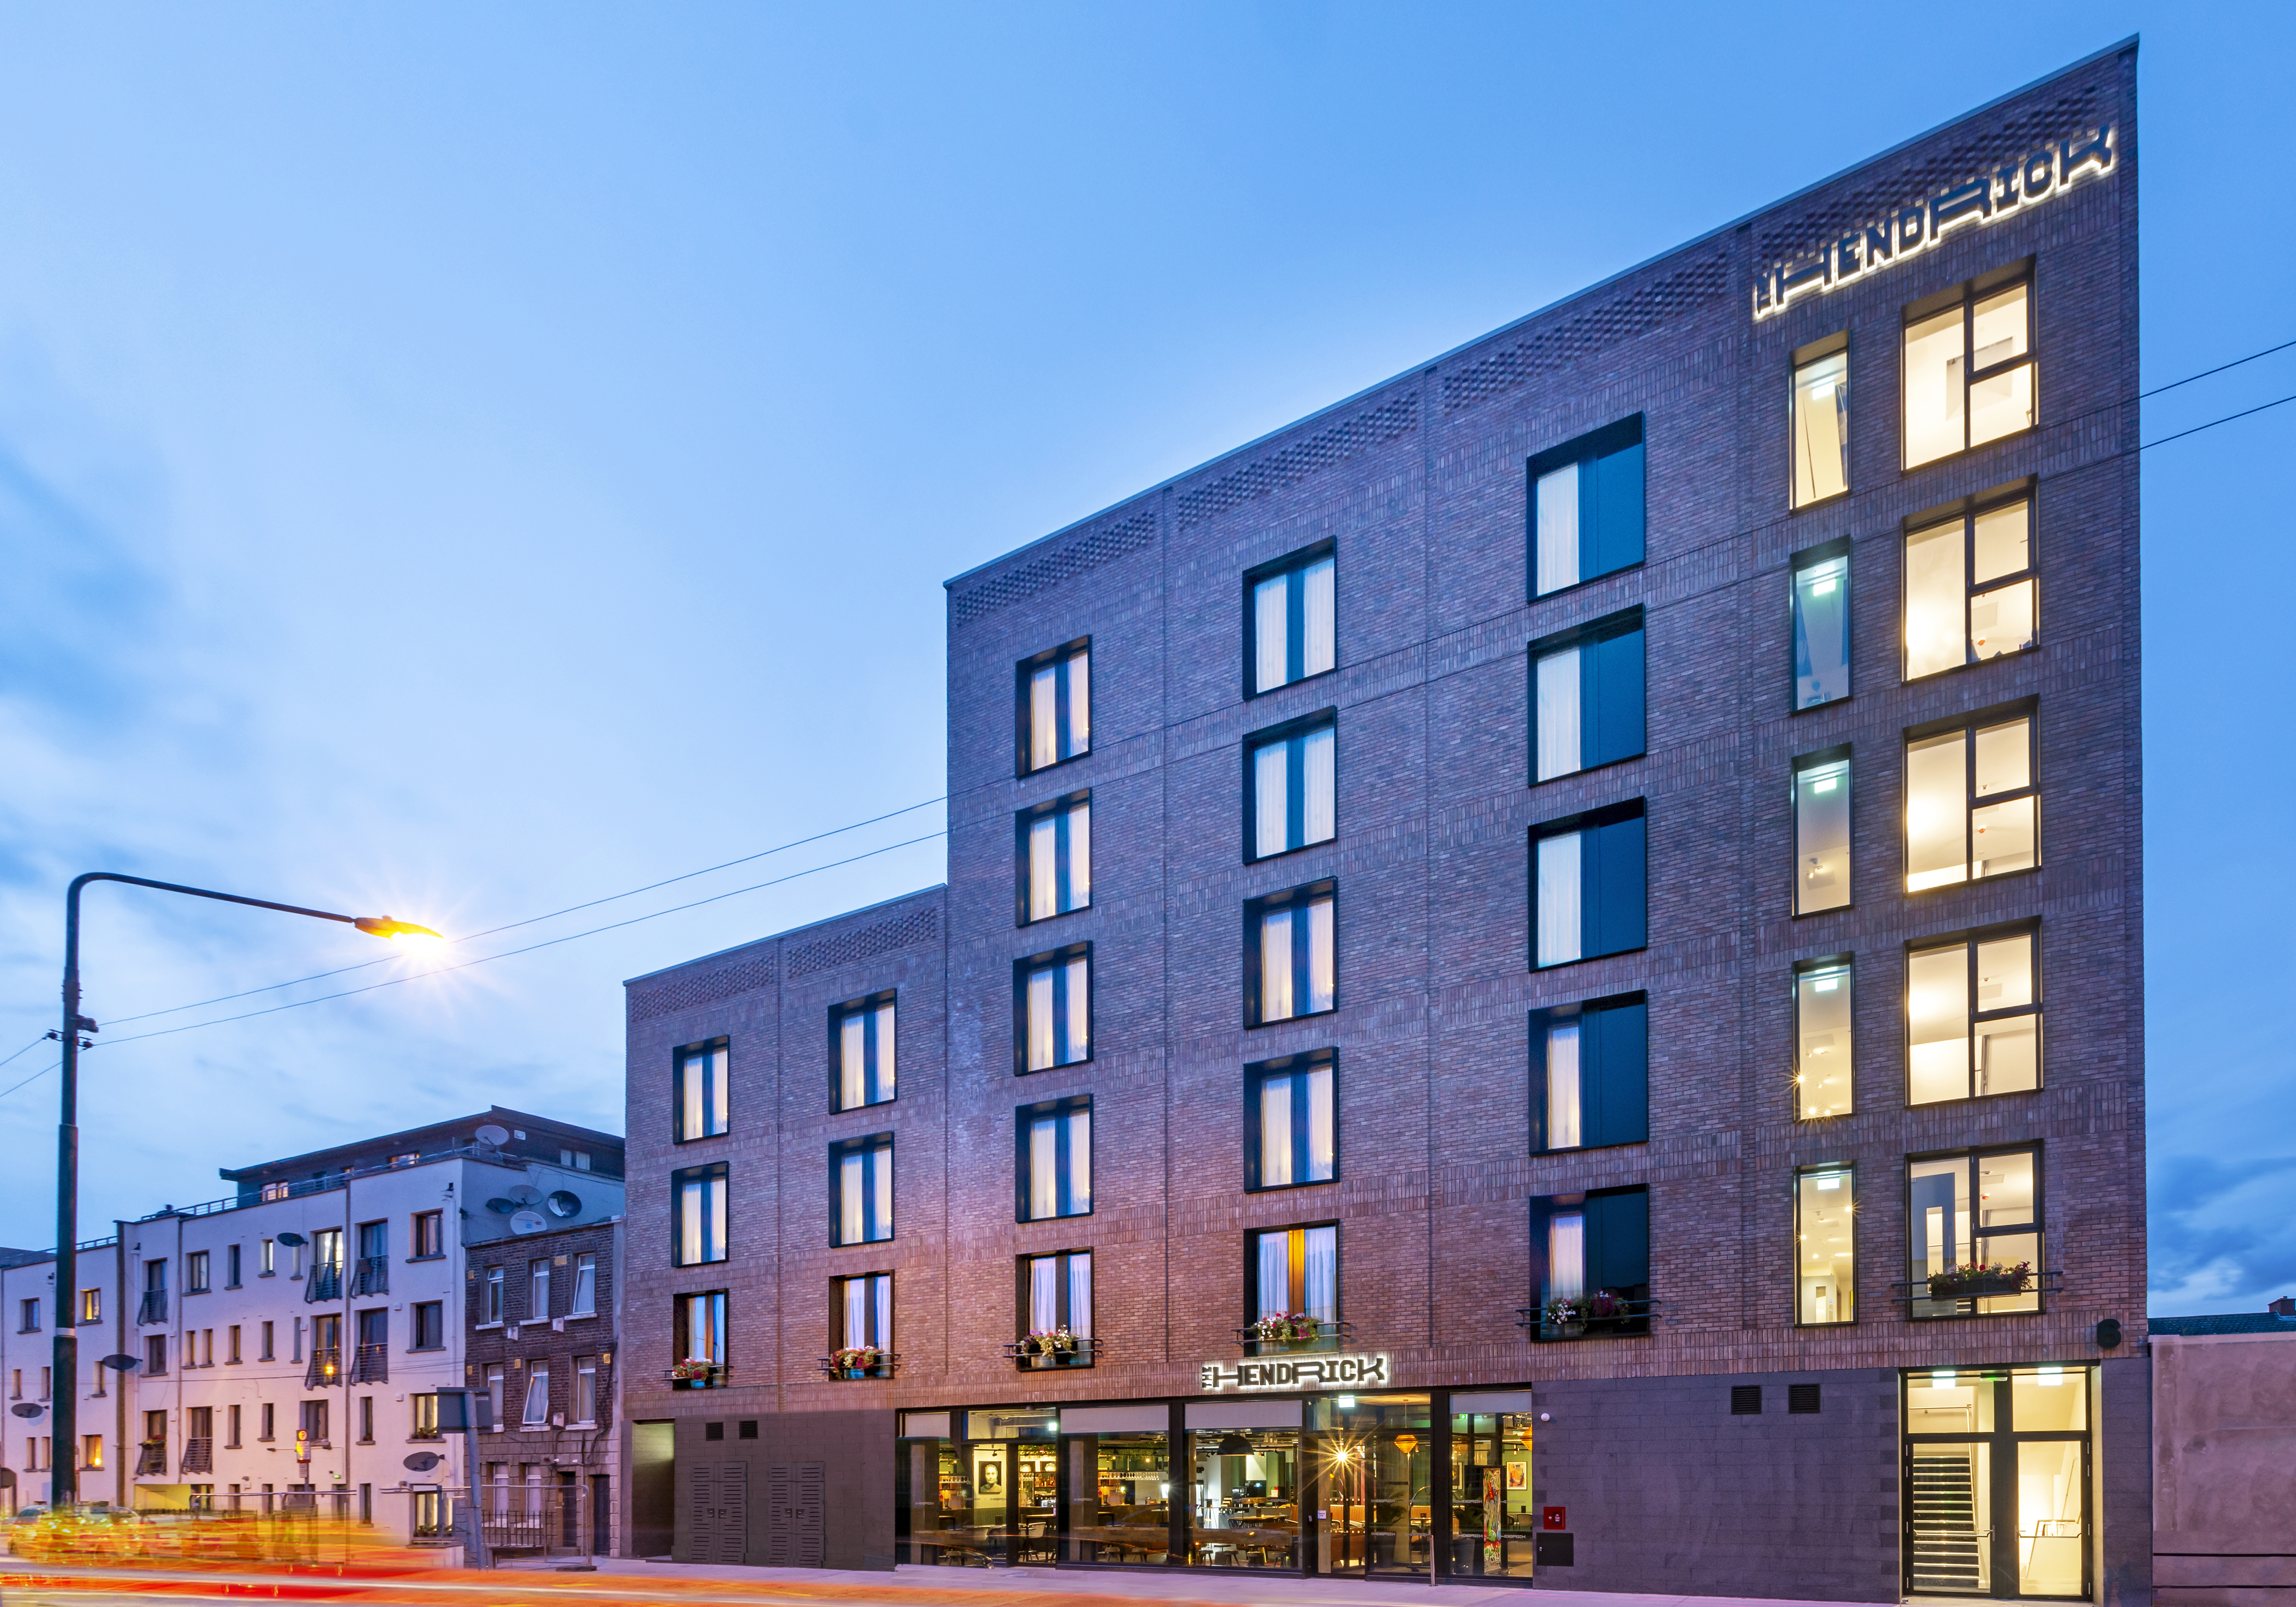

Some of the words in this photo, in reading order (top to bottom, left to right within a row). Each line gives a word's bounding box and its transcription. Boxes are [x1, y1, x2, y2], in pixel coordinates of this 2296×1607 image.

[1775, 123, 2112, 307] HENDRICK
[2097, 1319, 2122, 1348] 6
[1202, 1366, 1212, 1388] THE
[1213, 1358, 1385, 1387] HENDRICK
